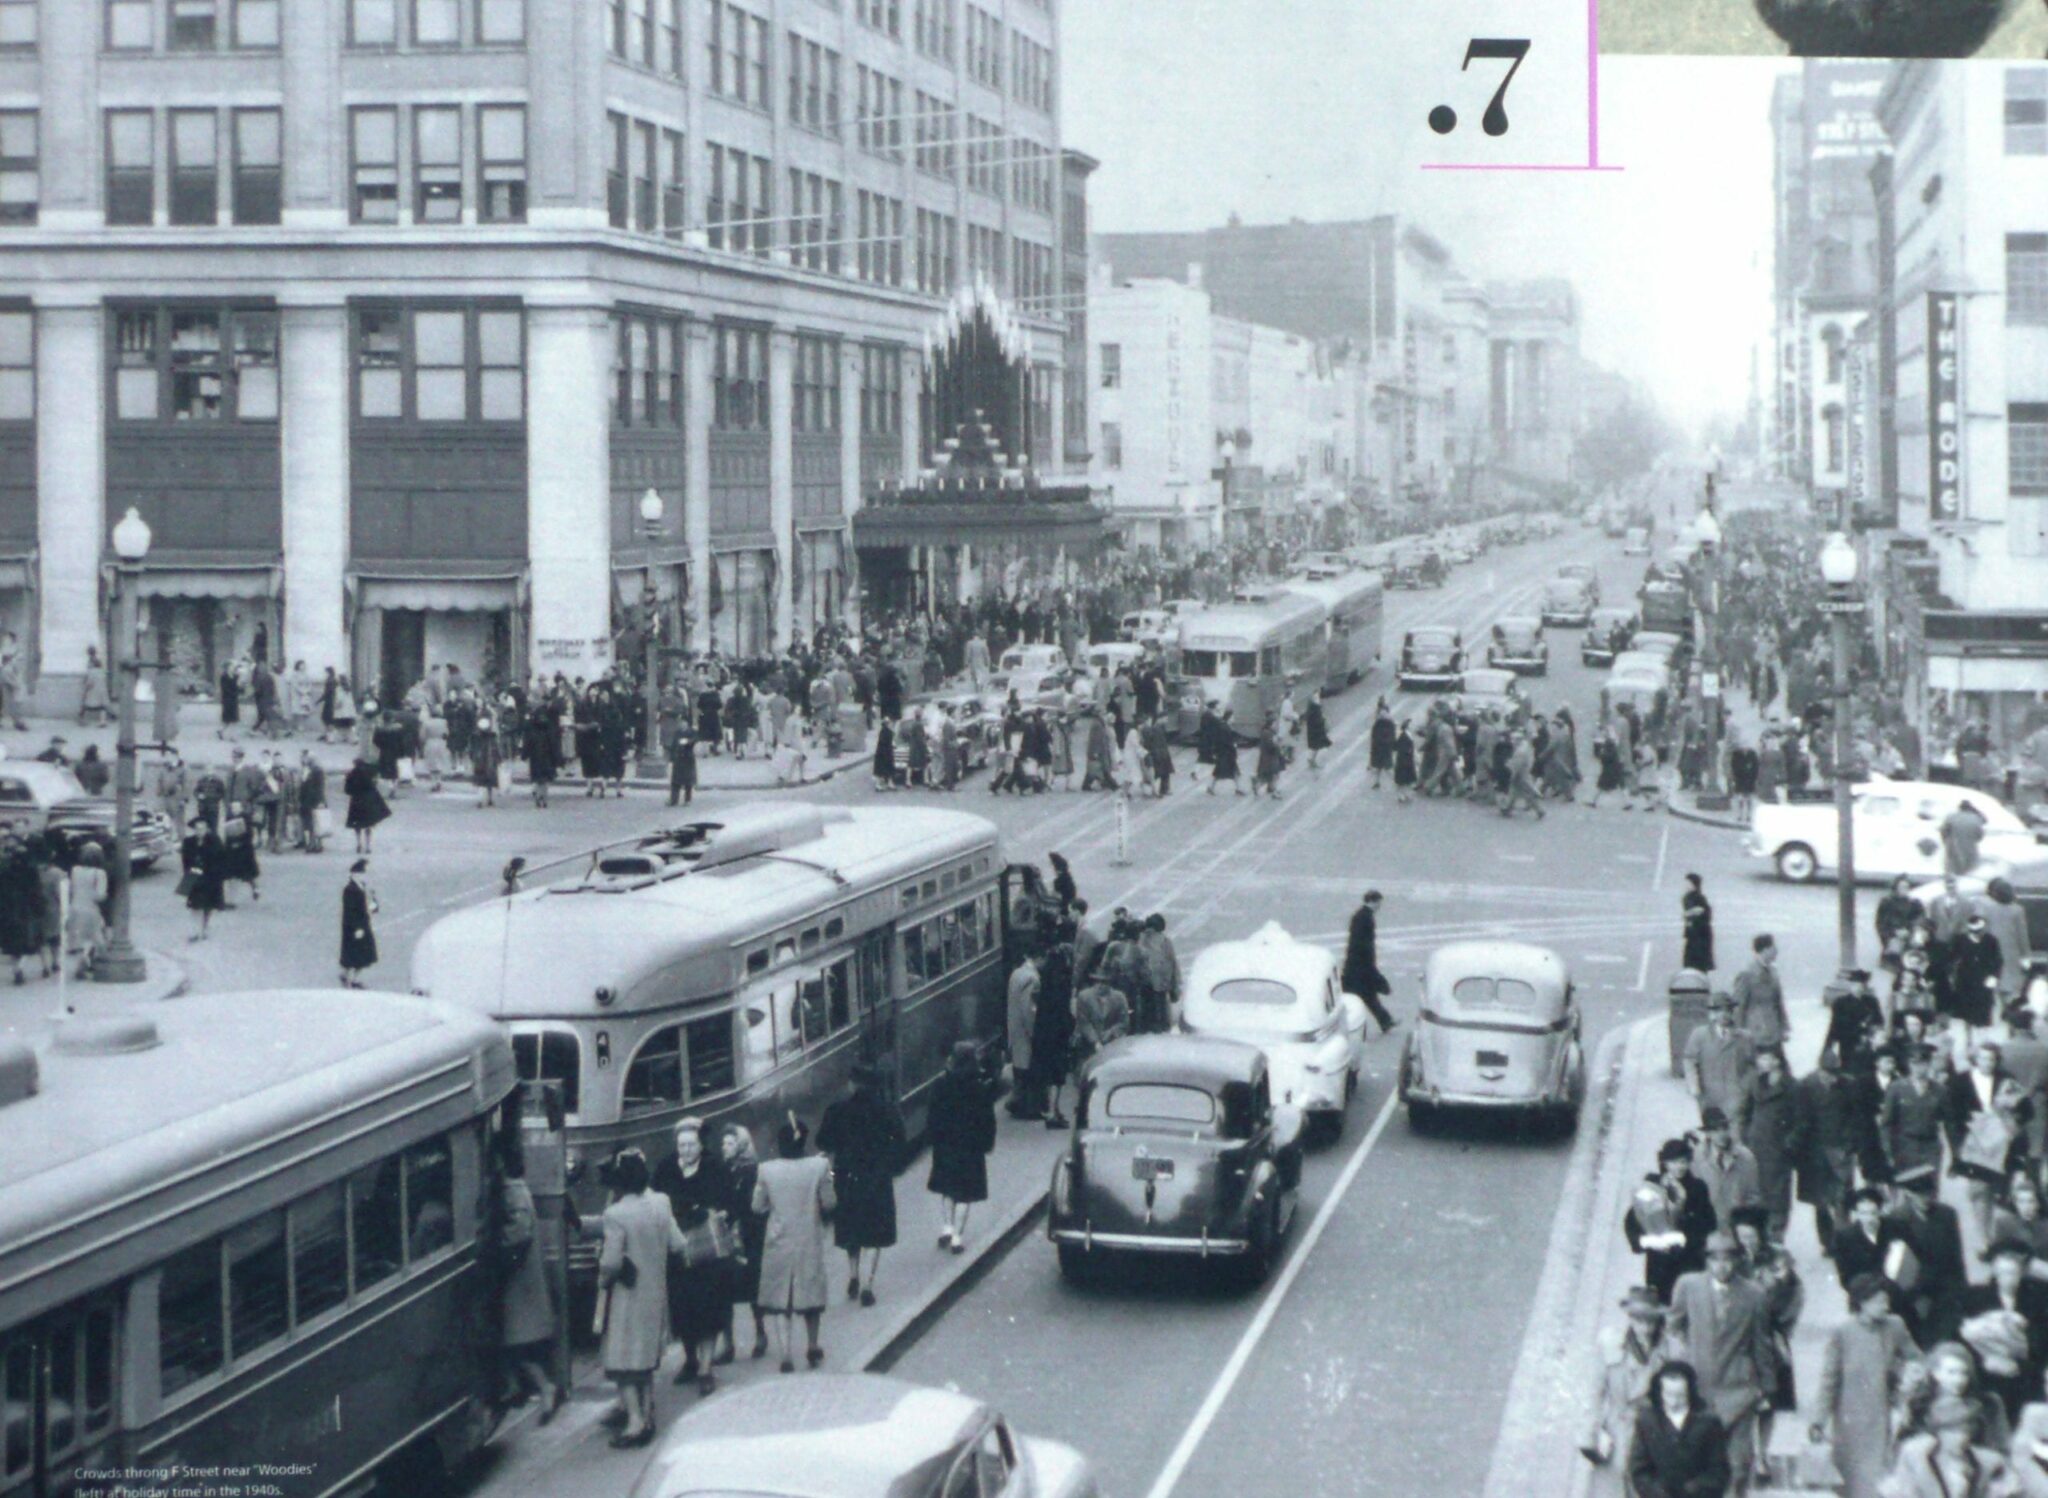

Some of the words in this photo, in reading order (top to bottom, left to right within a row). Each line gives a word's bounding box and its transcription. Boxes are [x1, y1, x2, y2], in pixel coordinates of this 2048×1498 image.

[1937, 301, 1957, 381] THE
[74, 1467, 121, 1479] Crowds
[125, 1466, 168, 1480] throng
[171, 1465, 179, 1477] F
[182, 1465, 219, 1477] Street
[223, 1467, 251, 1476] near
[122, 1486, 169, 1498] holiday
[172, 1487, 201, 1498] time
[204, 1486, 216, 1497] in
[220, 1485, 241, 1496] the
[244, 1484, 284, 1496] 1940s.
